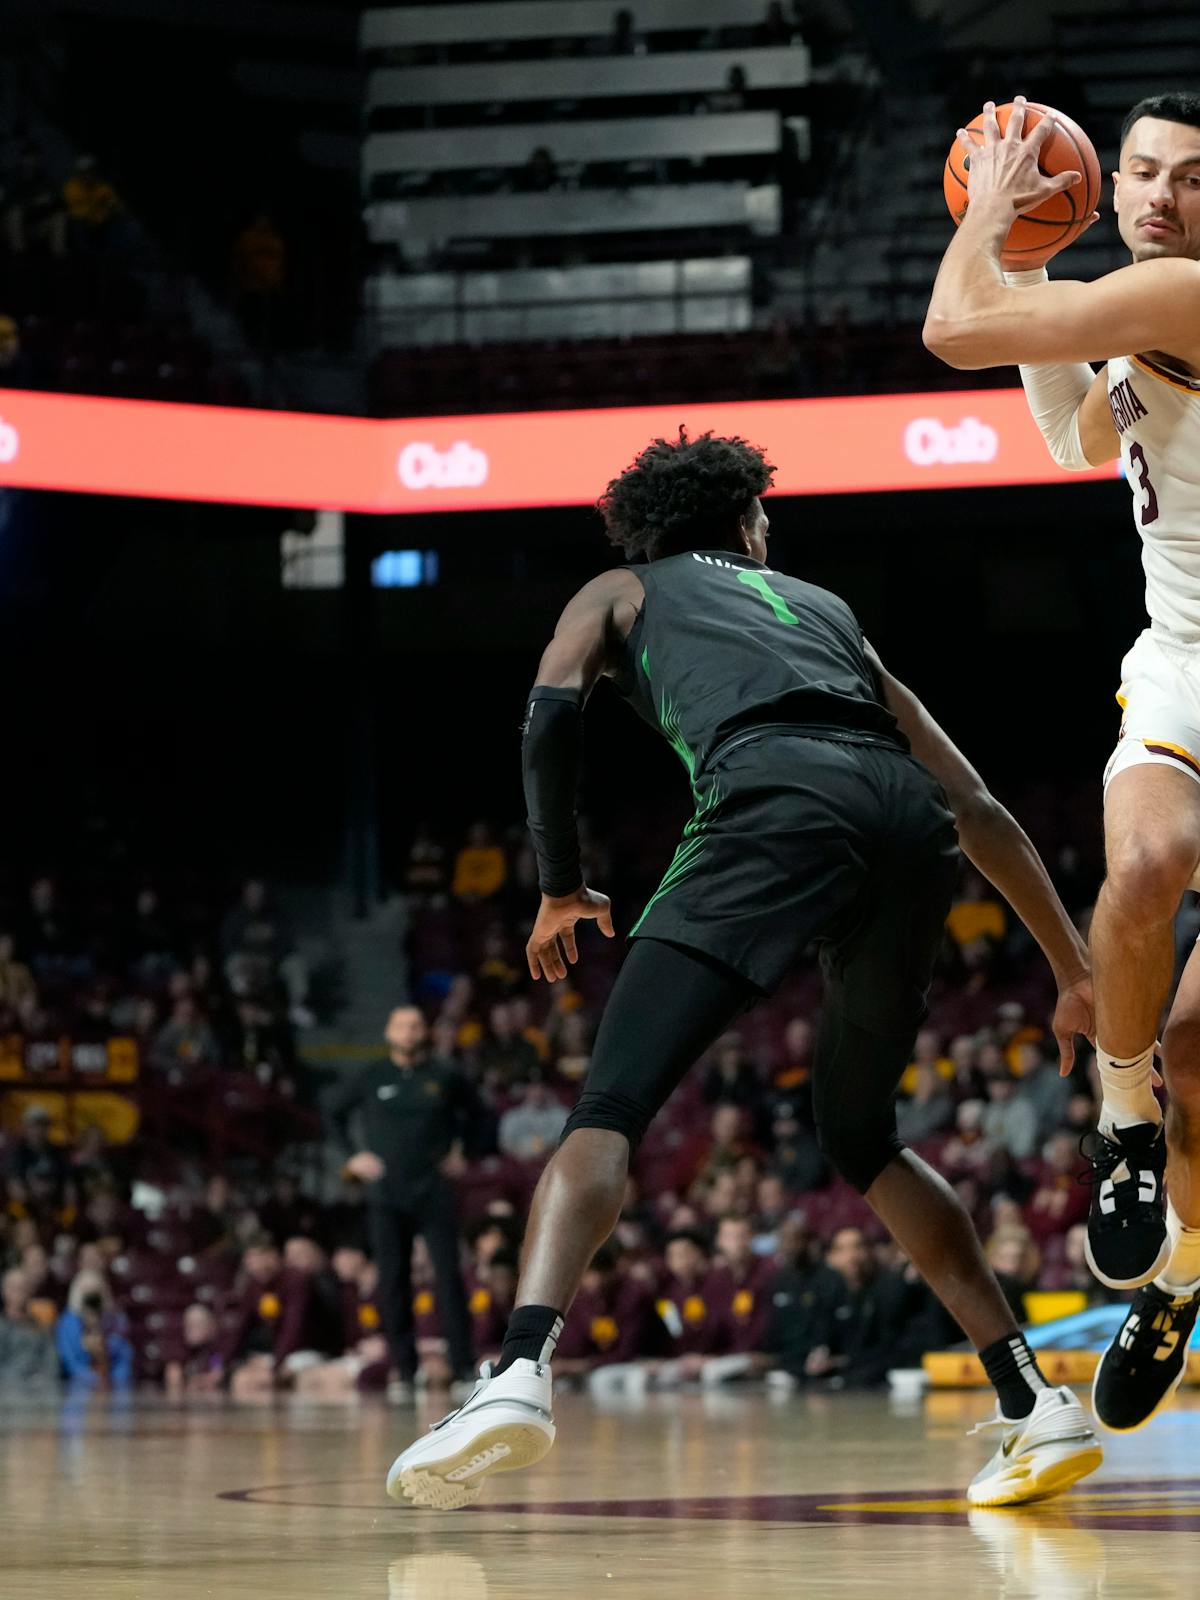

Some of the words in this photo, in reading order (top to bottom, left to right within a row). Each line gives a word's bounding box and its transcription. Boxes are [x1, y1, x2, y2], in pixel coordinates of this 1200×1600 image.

[397, 440, 488, 490] Cub
[903, 416, 997, 466] Cub
[1130, 441, 1159, 526] 3
[736, 570, 800, 625] 1
